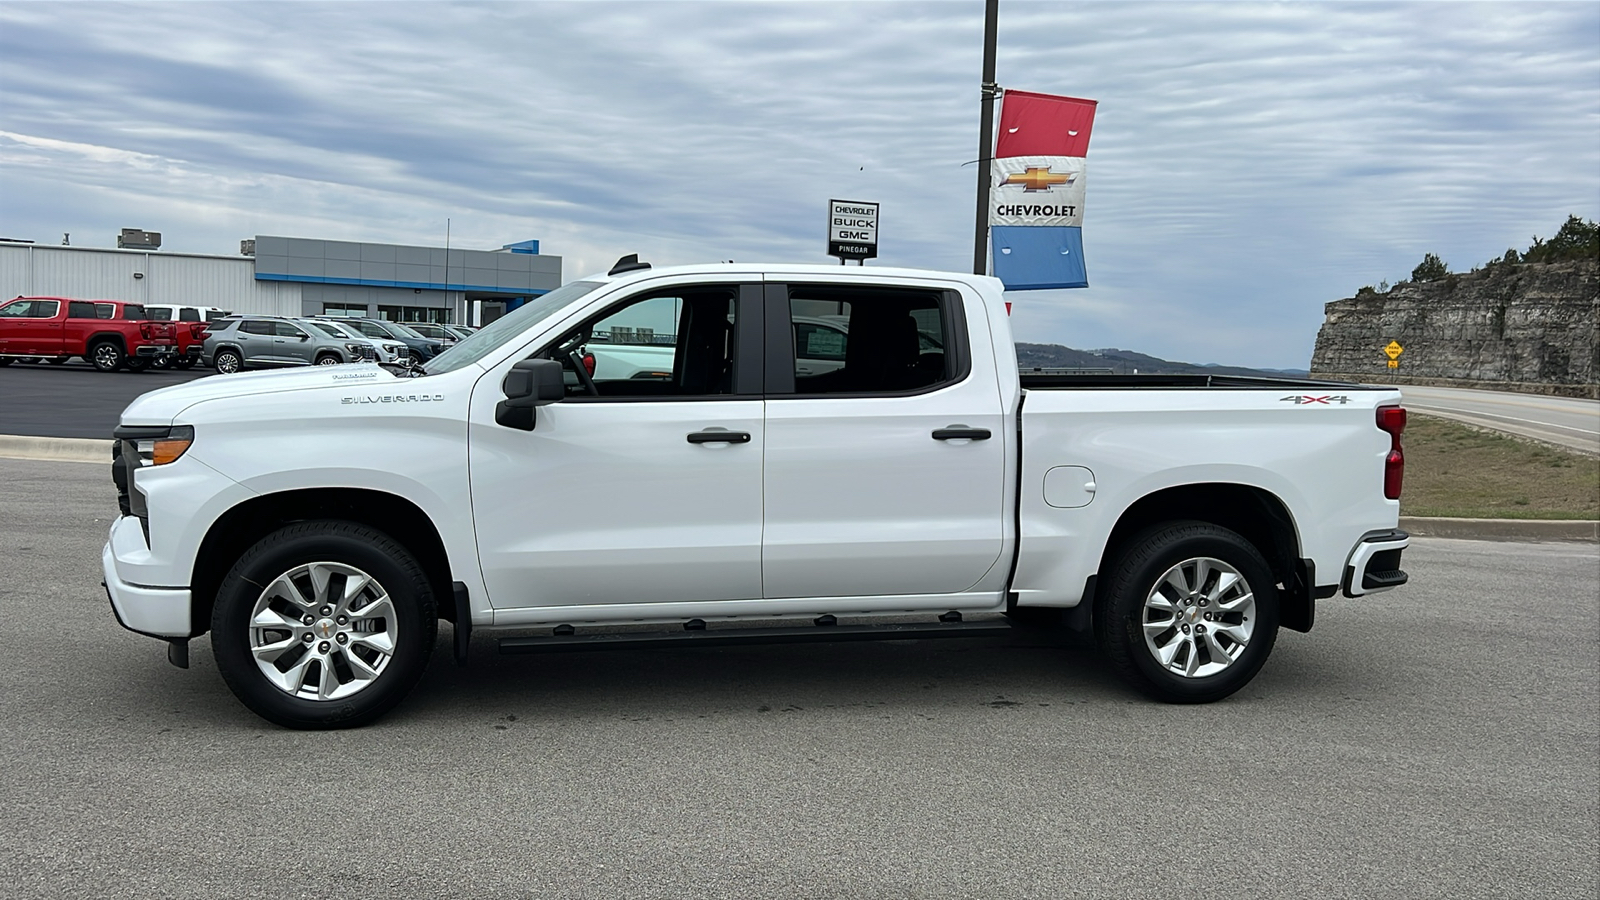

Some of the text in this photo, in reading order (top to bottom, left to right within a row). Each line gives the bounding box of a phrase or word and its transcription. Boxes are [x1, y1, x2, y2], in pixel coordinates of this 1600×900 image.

[835, 206, 875, 215] CHEVROLET
[997, 205, 1076, 217] CHEVROLET
[834, 218, 875, 228] BUICK
[839, 231, 869, 240] GMC
[341, 395, 445, 404] SILVERADO
